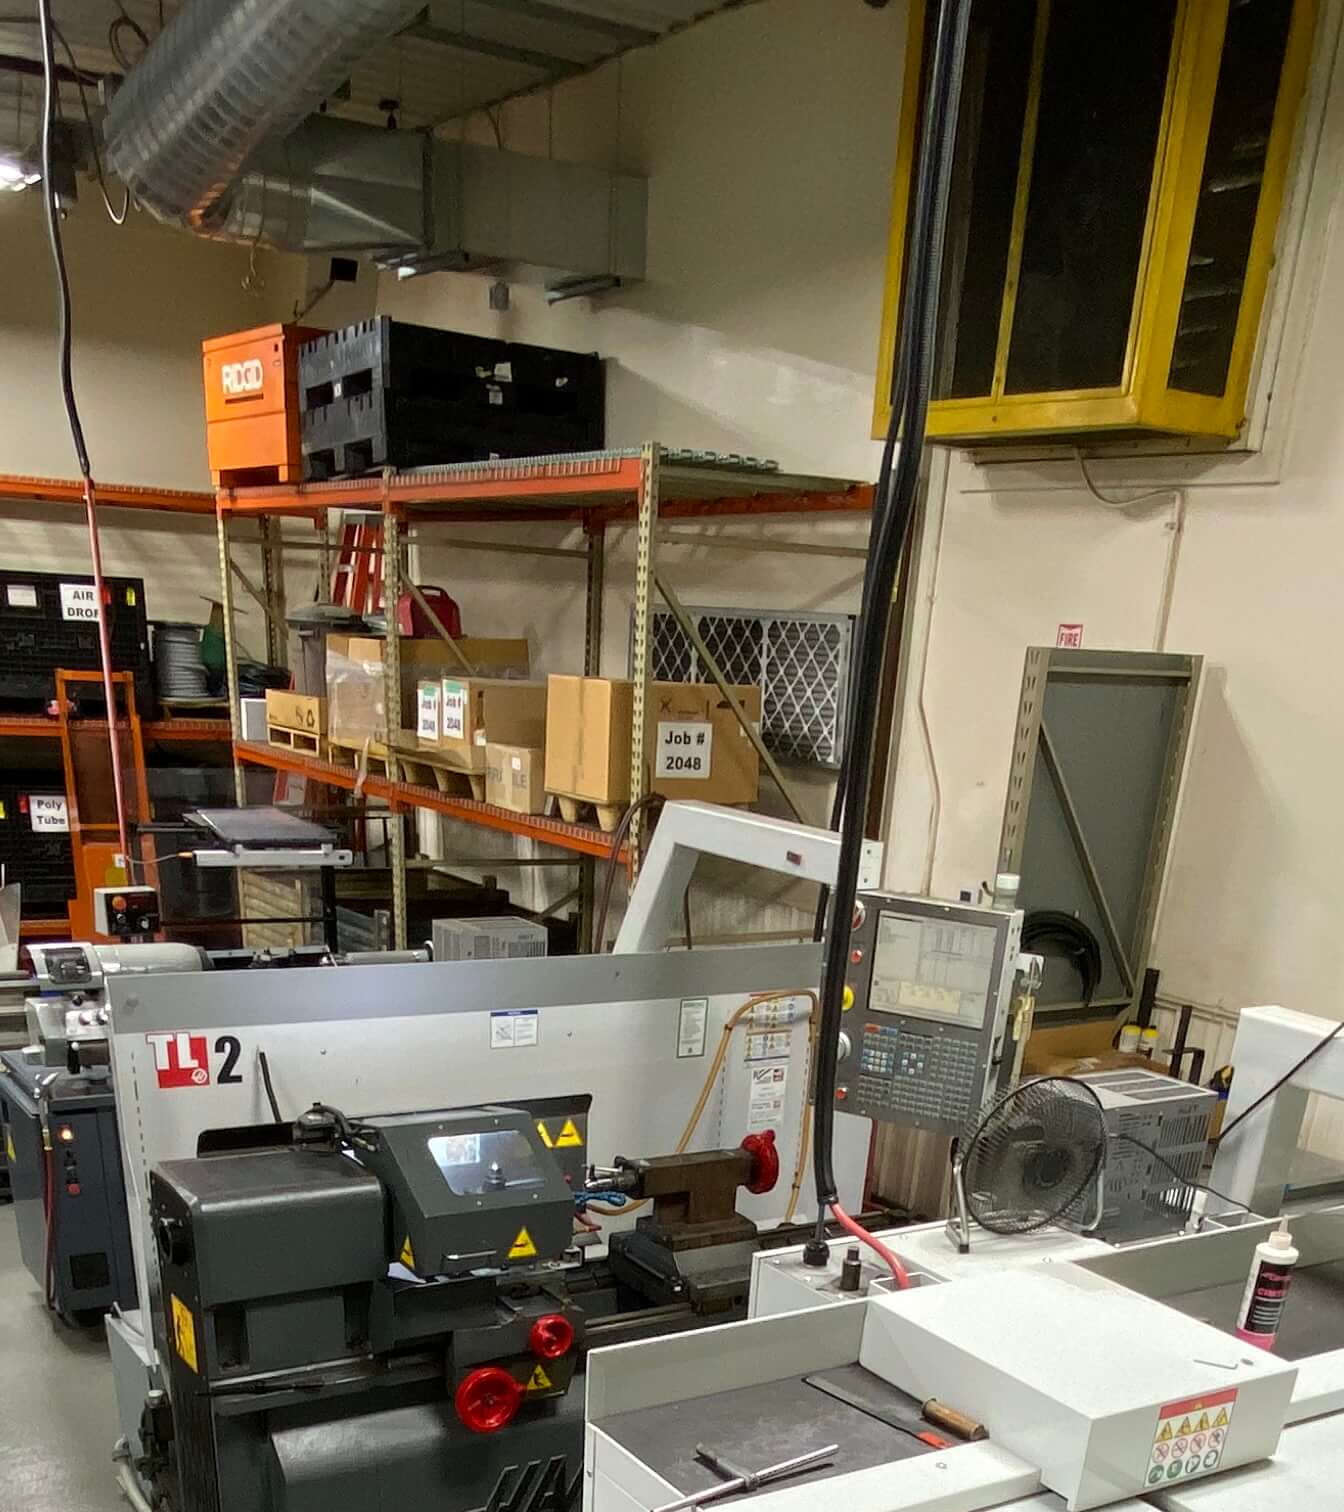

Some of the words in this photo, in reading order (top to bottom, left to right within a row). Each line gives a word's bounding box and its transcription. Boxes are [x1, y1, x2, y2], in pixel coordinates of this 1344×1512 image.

[73, 591, 93, 601] AIR
[1059, 632, 1078, 647] FIRE
[665, 731, 691, 745] Job
[696, 732, 705, 745] #
[666, 757, 702, 770] 2048
[37, 800, 62, 811] Poly
[37, 816, 65, 824] Tube
[146, 1032, 199, 1071] TL
[214, 1035, 243, 1084] 2
